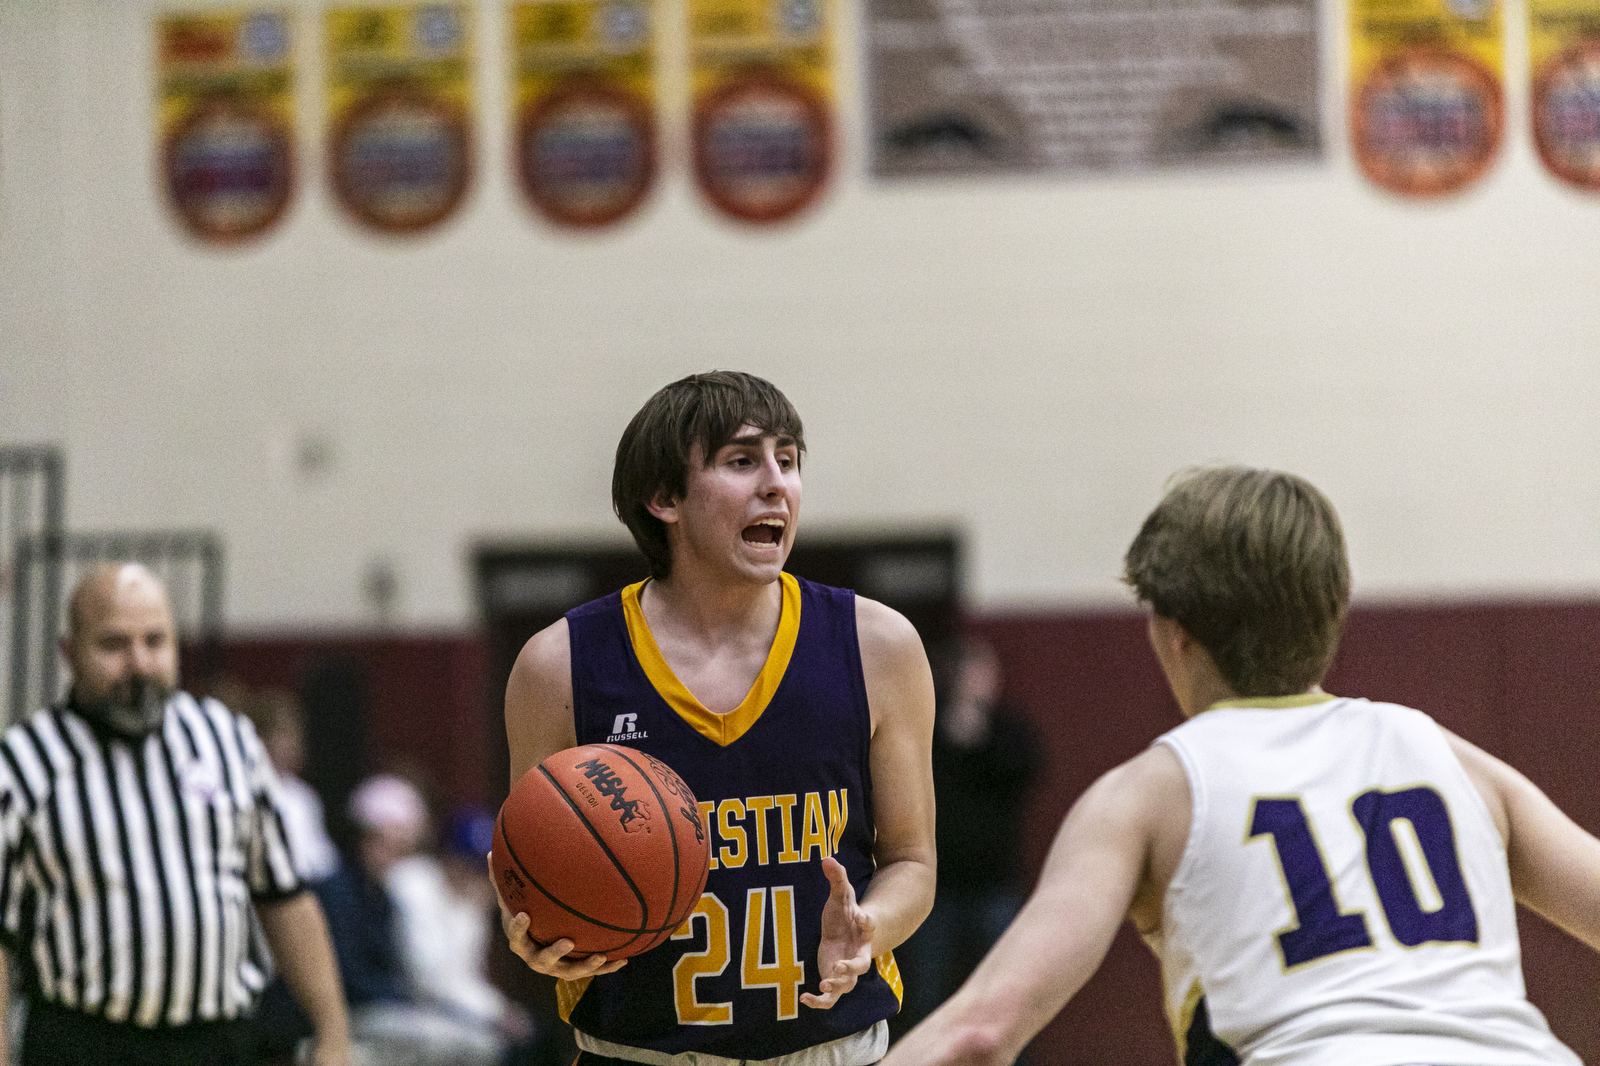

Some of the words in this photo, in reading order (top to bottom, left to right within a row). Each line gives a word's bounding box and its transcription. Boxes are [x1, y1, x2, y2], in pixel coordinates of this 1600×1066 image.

[612, 712, 638, 734] R
[606, 731, 649, 743] RUSSELL
[575, 782, 599, 808] DELTON
[1243, 782, 1479, 974] 10
[670, 885, 805, 1025] 24
